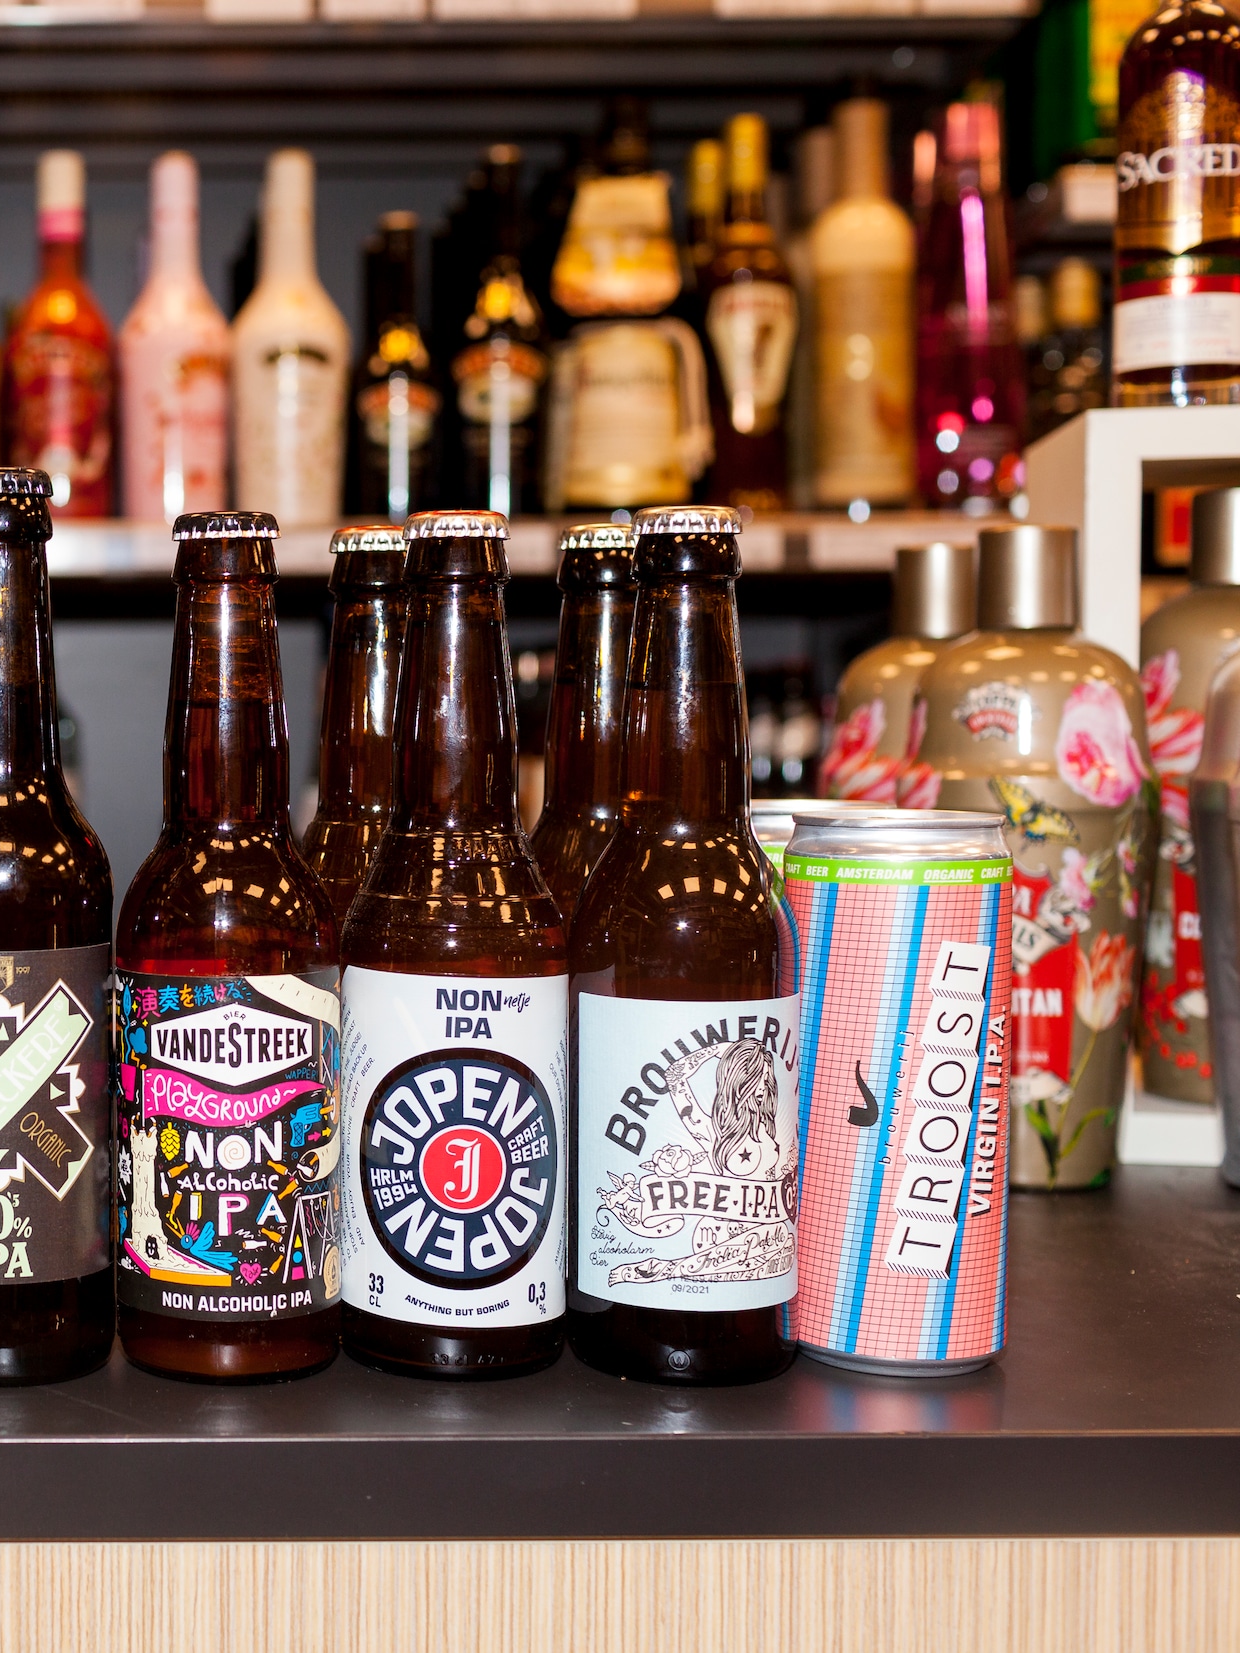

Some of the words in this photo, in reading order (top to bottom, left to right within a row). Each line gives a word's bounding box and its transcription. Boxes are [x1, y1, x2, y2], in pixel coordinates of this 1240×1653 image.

[1117, 143, 1240, 193] SACRED
[806, 865, 829, 877] BEER
[835, 867, 914, 880] AMSTERDAM
[923, 868, 974, 881] ORGANIC
[980, 866, 1004, 879] CRAFT
[135, 983, 244, 1020] 演奏を続ける
[436, 988, 502, 1011] NON
[503, 992, 530, 1014] netje
[223, 1011, 246, 1020] BIER
[445, 1016, 492, 1039] IPA
[156, 1022, 308, 1068] VANDESTREEK
[360, 1043, 368, 1055] UP
[982, 1005, 1006, 1089] I.P.A.
[352, 1053, 362, 1073] BACK
[360, 1057, 375, 1077] BEER.
[346, 1073, 354, 1094] HEAD
[350, 1080, 361, 1108] CRAFT
[604, 1015, 798, 1156] BROUWERIJ
[878, 1028, 916, 1167] brouwerij
[898, 951, 980, 1256] TROOST
[371, 1065, 537, 1165] JOPEN
[19, 1111, 72, 1168] ORGANIC
[185, 1120, 283, 1171] NON
[508, 1115, 545, 1150] CRAFT
[510, 1137, 549, 1165] BEER
[968, 1097, 1000, 1218] VIRGIN
[370, 1167, 414, 1188] HRLM
[348, 1188, 357, 1219] ENJOY
[373, 1183, 418, 1210] 1994
[646, 1180, 730, 1212] FREE
[189, 1192, 288, 1237] IPA
[343, 1191, 352, 1230] READING
[384, 1167, 548, 1272] JOPEN
[348, 1232, 358, 1254] STOP
[355, 1227, 366, 1246] AND
[598, 1242, 655, 1254] alcoholarm
[589, 1251, 609, 1266] Bier
[684, 1246, 743, 1273] India
[742, 1230, 772, 1265] Pale
[368, 1272, 384, 1295] 33
[528, 1282, 546, 1308] 0,3
[671, 1283, 709, 1294] 09/2021
[162, 1291, 194, 1310] NON
[197, 1294, 287, 1312] ALCOHOLIC
[291, 1290, 312, 1307] IPA
[369, 1295, 381, 1308] CL
[404, 1294, 452, 1316] ANYTHING
[455, 1307, 474, 1317] BUT
[477, 1299, 510, 1316] BORING
[538, 1304, 546, 1315] %
